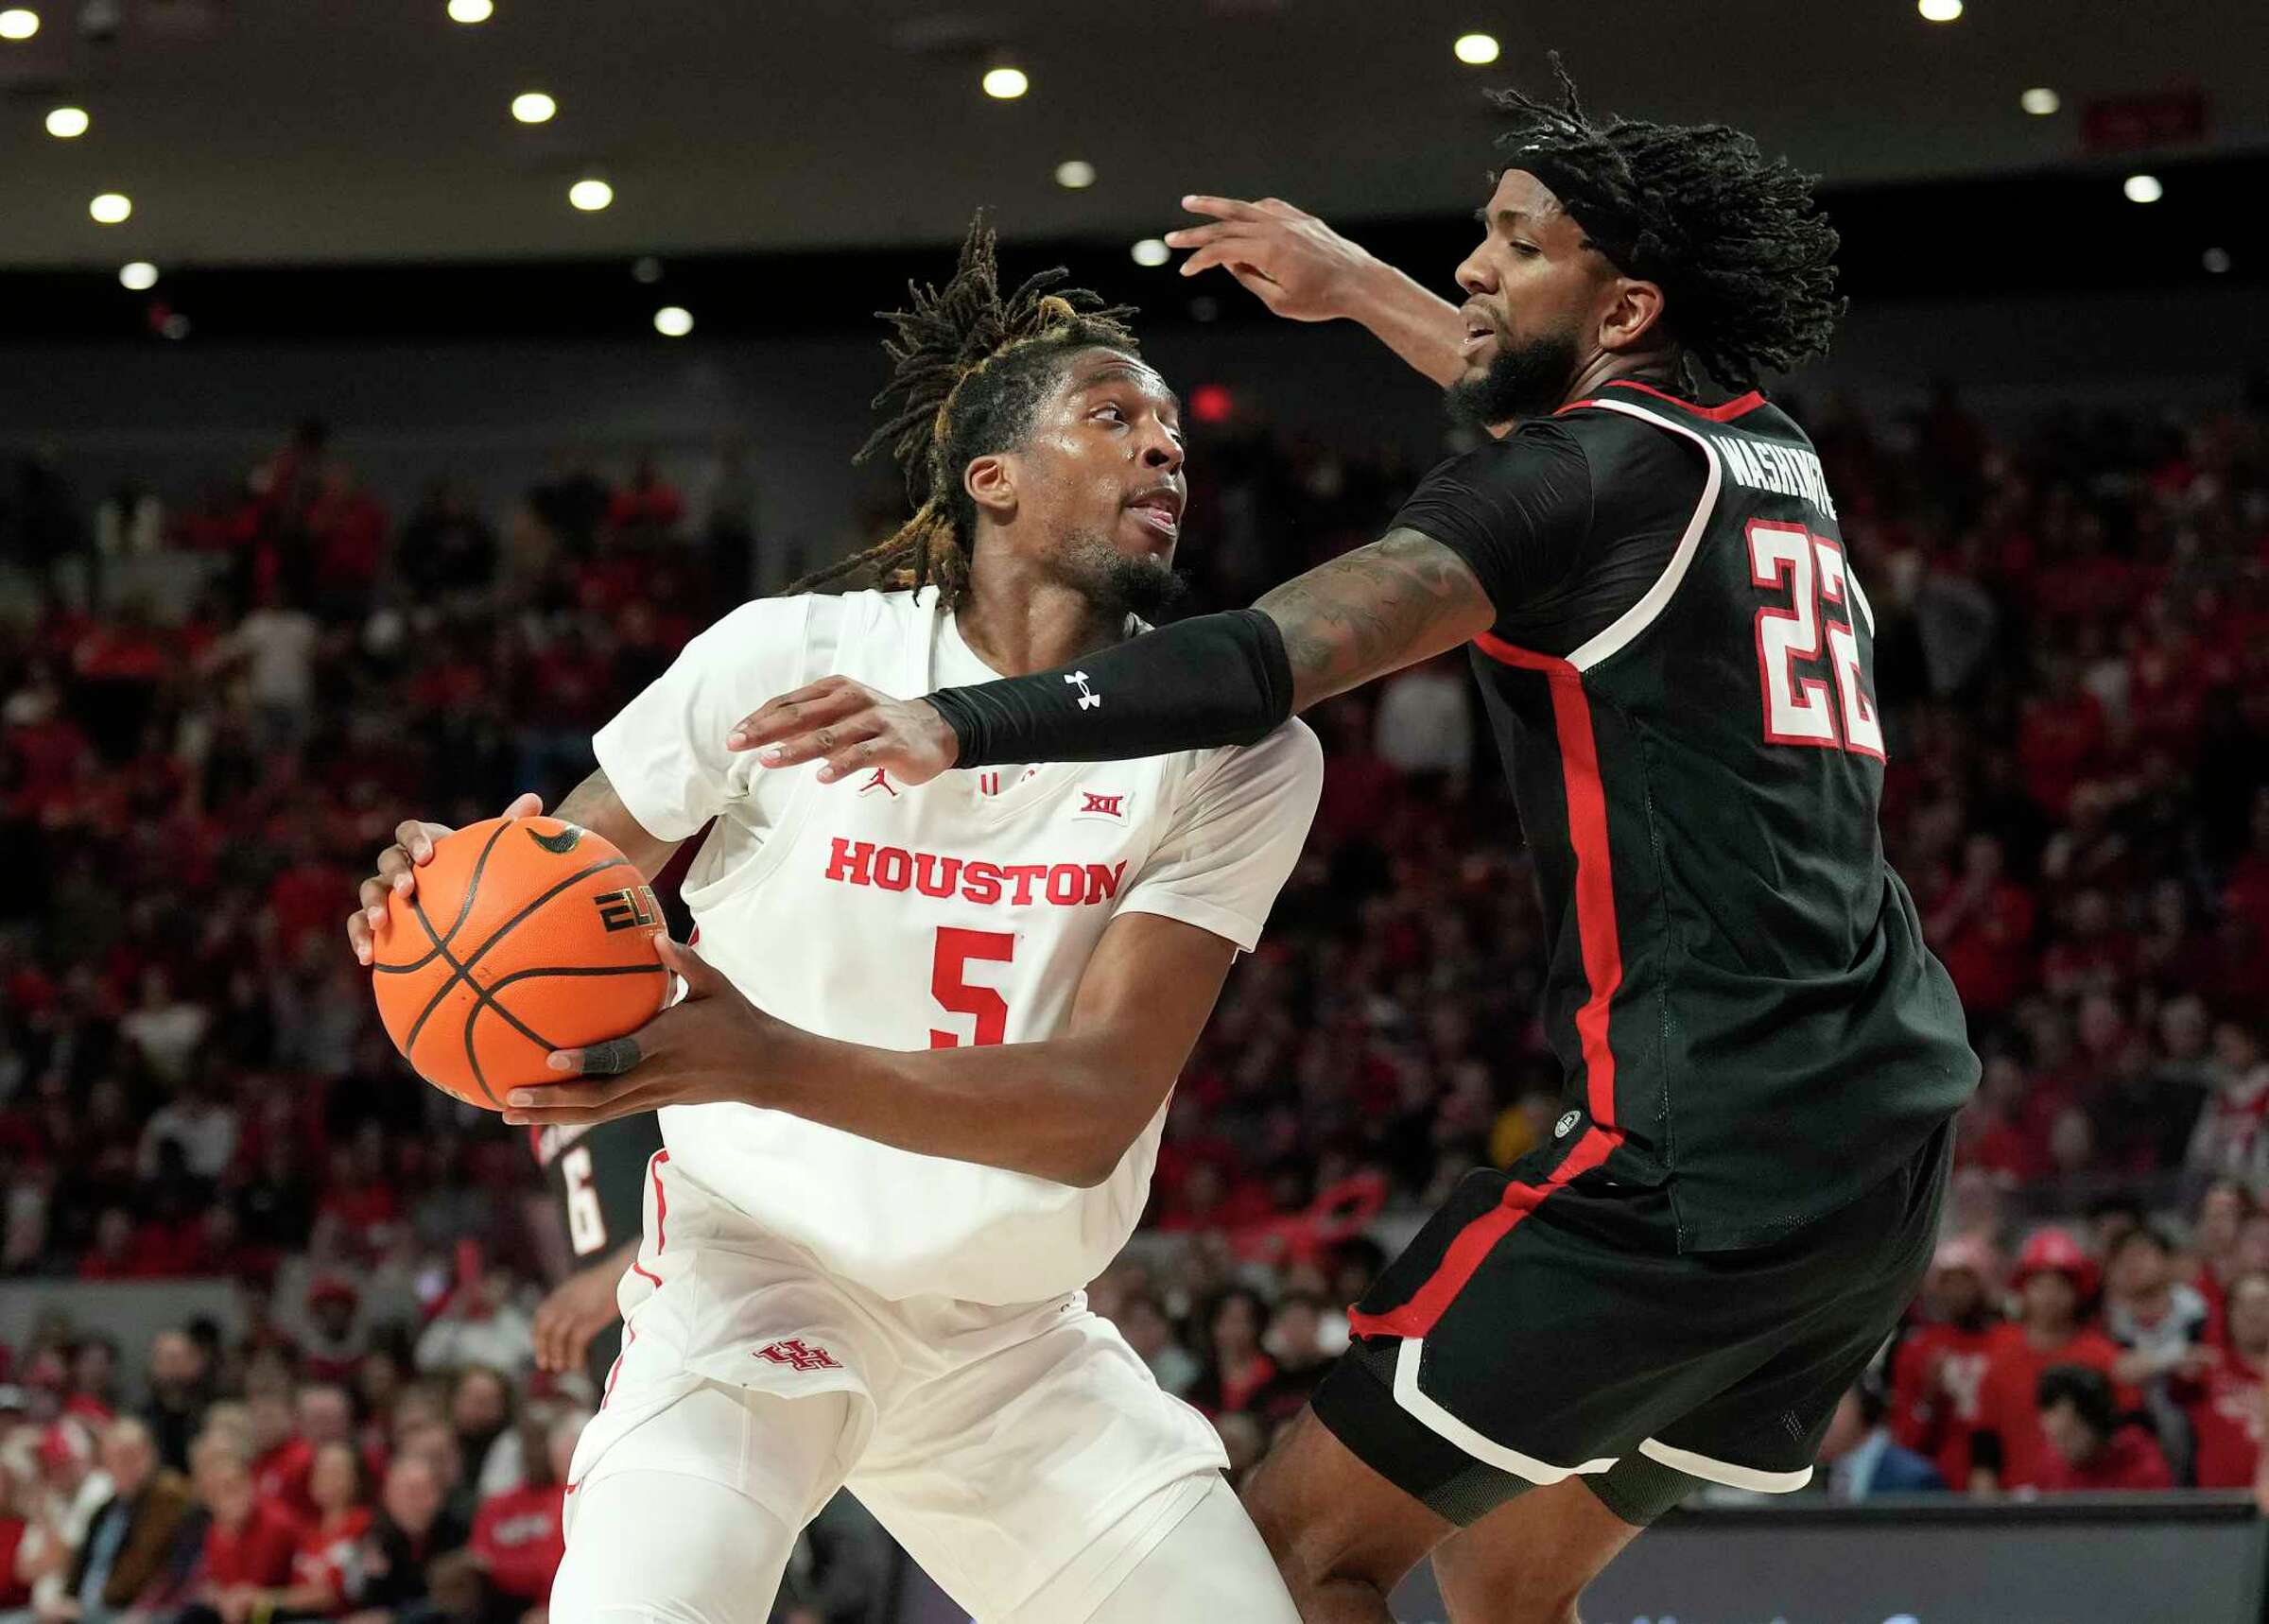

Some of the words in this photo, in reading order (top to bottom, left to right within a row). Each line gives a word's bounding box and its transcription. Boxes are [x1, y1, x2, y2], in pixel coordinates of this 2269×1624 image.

[1745, 516, 1887, 765] 22
[825, 837, 1128, 906] HOUSTON
[929, 925, 1015, 1050] 5
[562, 1147, 608, 1257] 6
